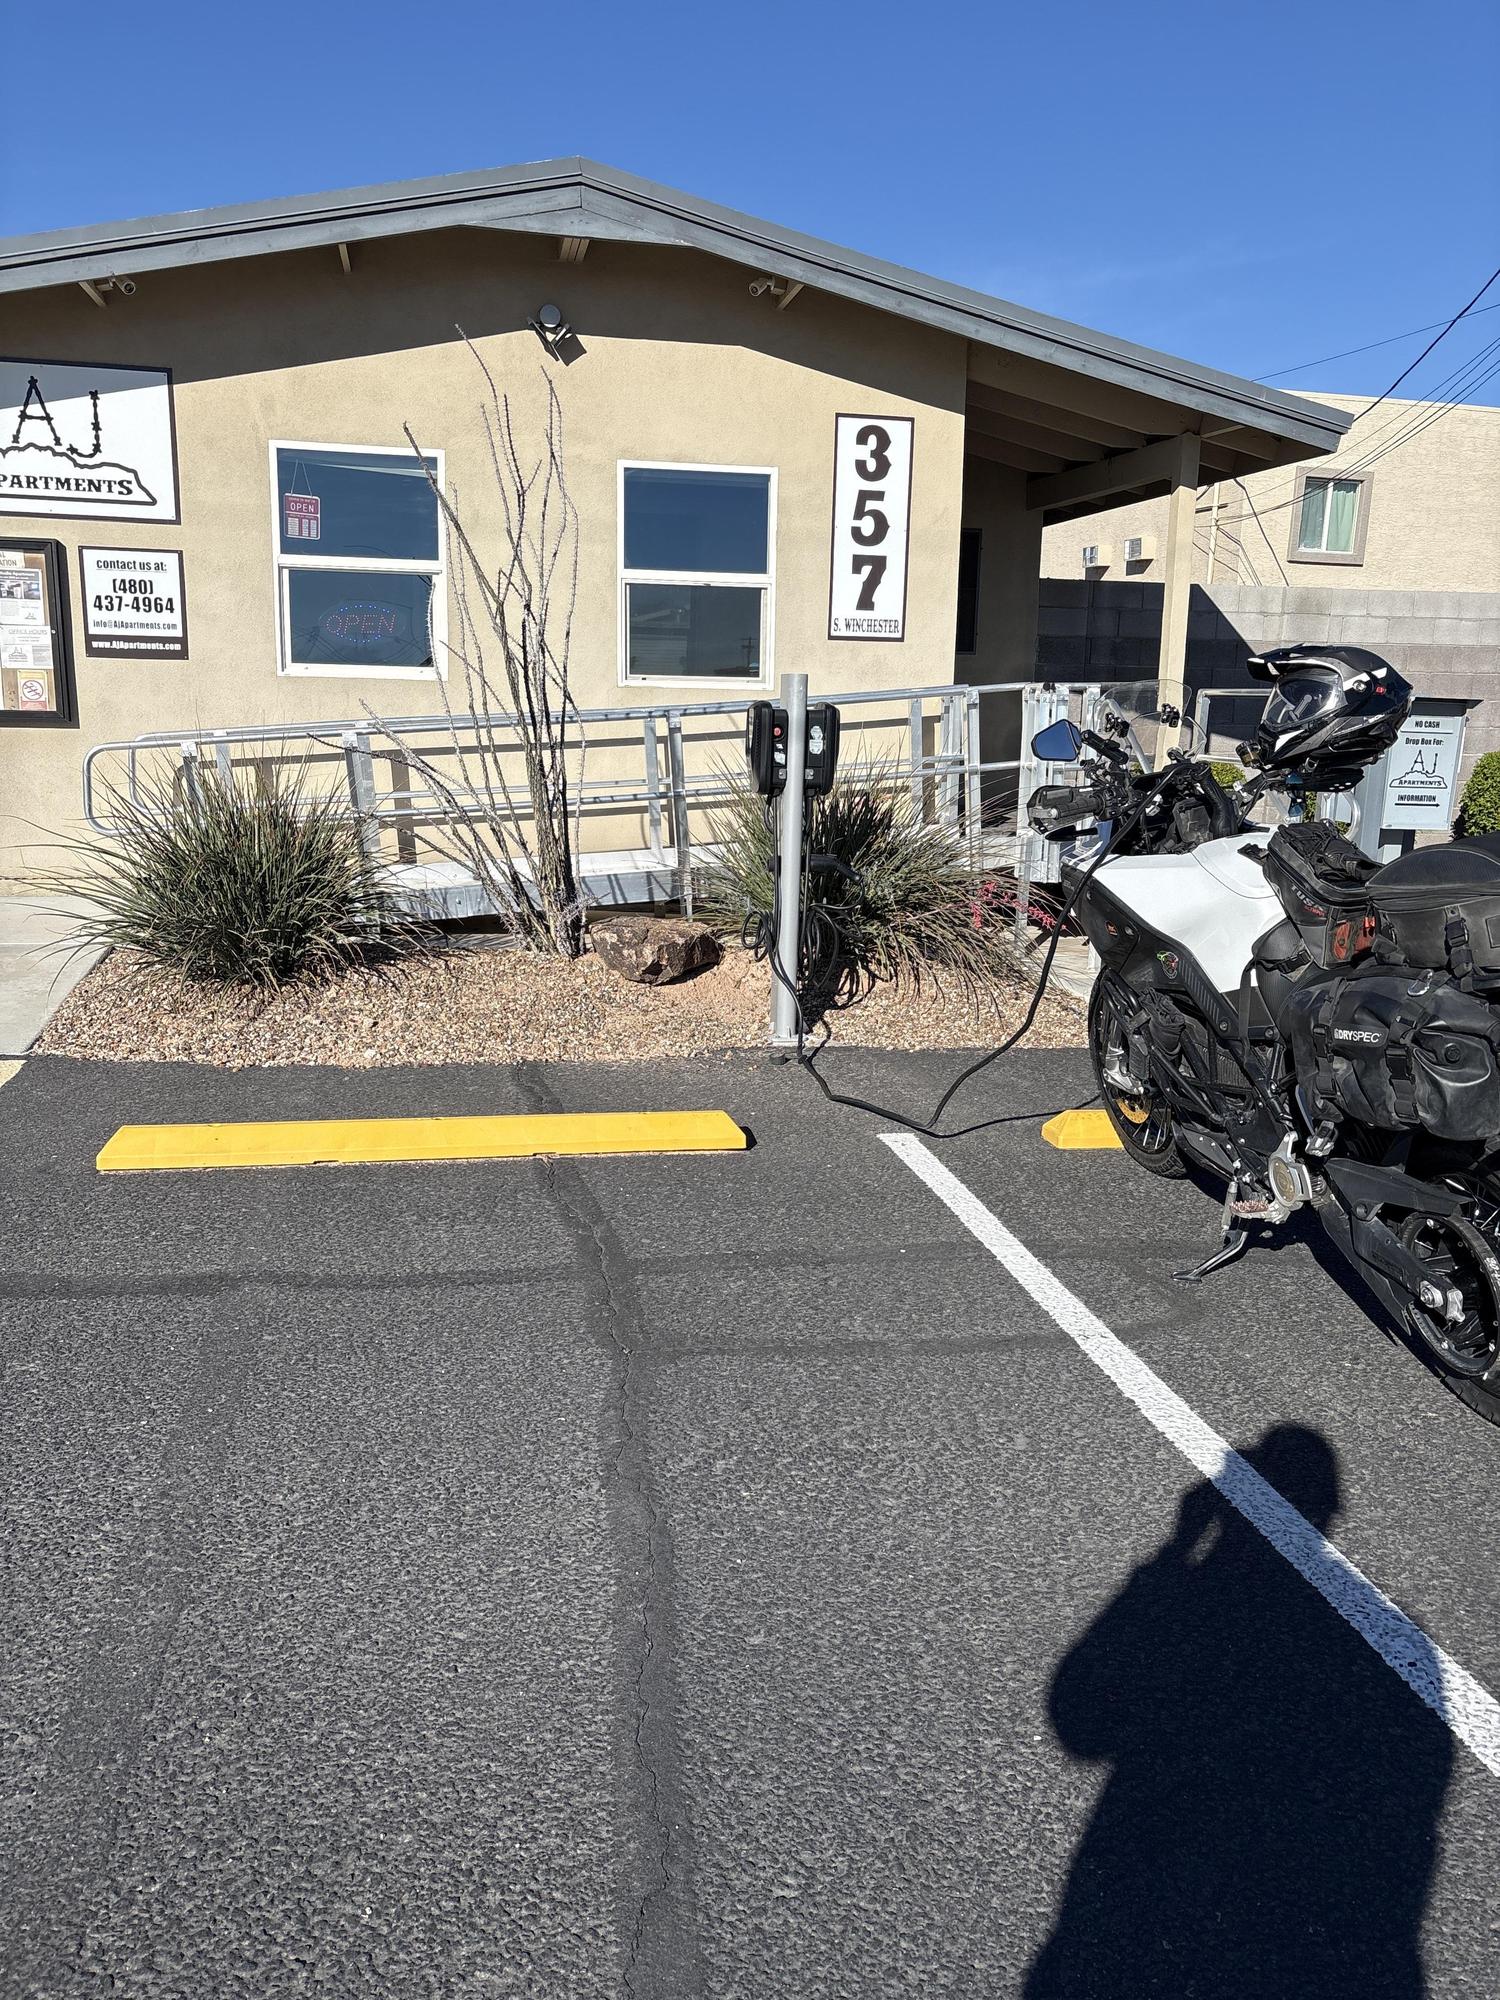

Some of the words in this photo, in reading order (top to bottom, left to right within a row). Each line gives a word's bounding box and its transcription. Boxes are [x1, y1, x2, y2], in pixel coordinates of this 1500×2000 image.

[290, 502, 315, 513] OPEN
[96, 559, 137, 571] contact
[139, 561, 152, 571] us
[153, 562, 168, 572] at:
[112, 578, 154, 595] (480)
[93, 594, 175, 614] 437-4964
[326, 613, 397, 633] OPEN
[845, 618, 900, 634] WINCHESTER
[1414, 720, 1423, 728] NO
[1424, 720, 1440, 729] CASH
[1405, 737, 1419, 746] Drop
[1398, 779, 1442, 787] APARTMENTS
[1397, 794, 1436, 802] INFORMATION
